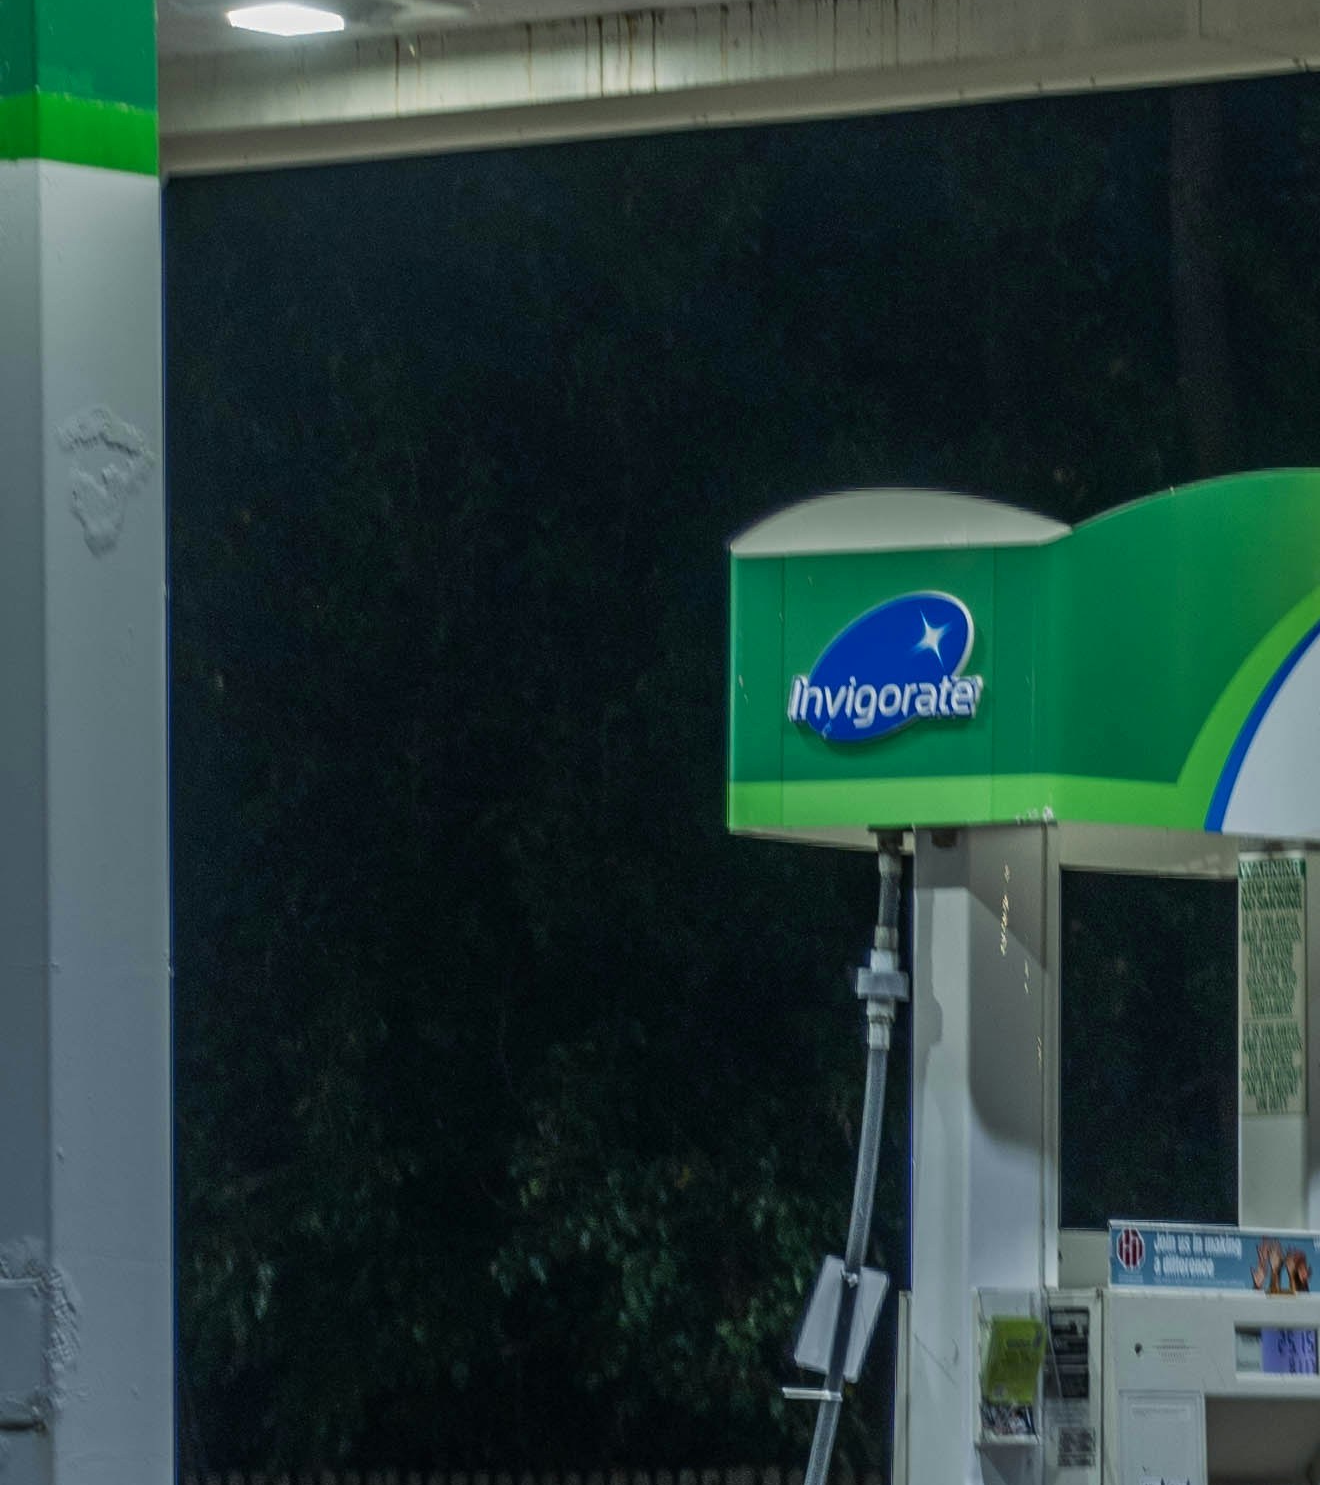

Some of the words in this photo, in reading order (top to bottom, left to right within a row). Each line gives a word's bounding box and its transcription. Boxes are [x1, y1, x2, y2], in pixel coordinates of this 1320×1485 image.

[788, 675, 981, 728] Invigorate
[1153, 1232, 1176, 1253] Join
[1177, 1235, 1191, 1253] us
[1192, 1232, 1203, 1252] in
[1205, 1234, 1242, 1259] making
[1154, 1256, 1162, 1275] a
